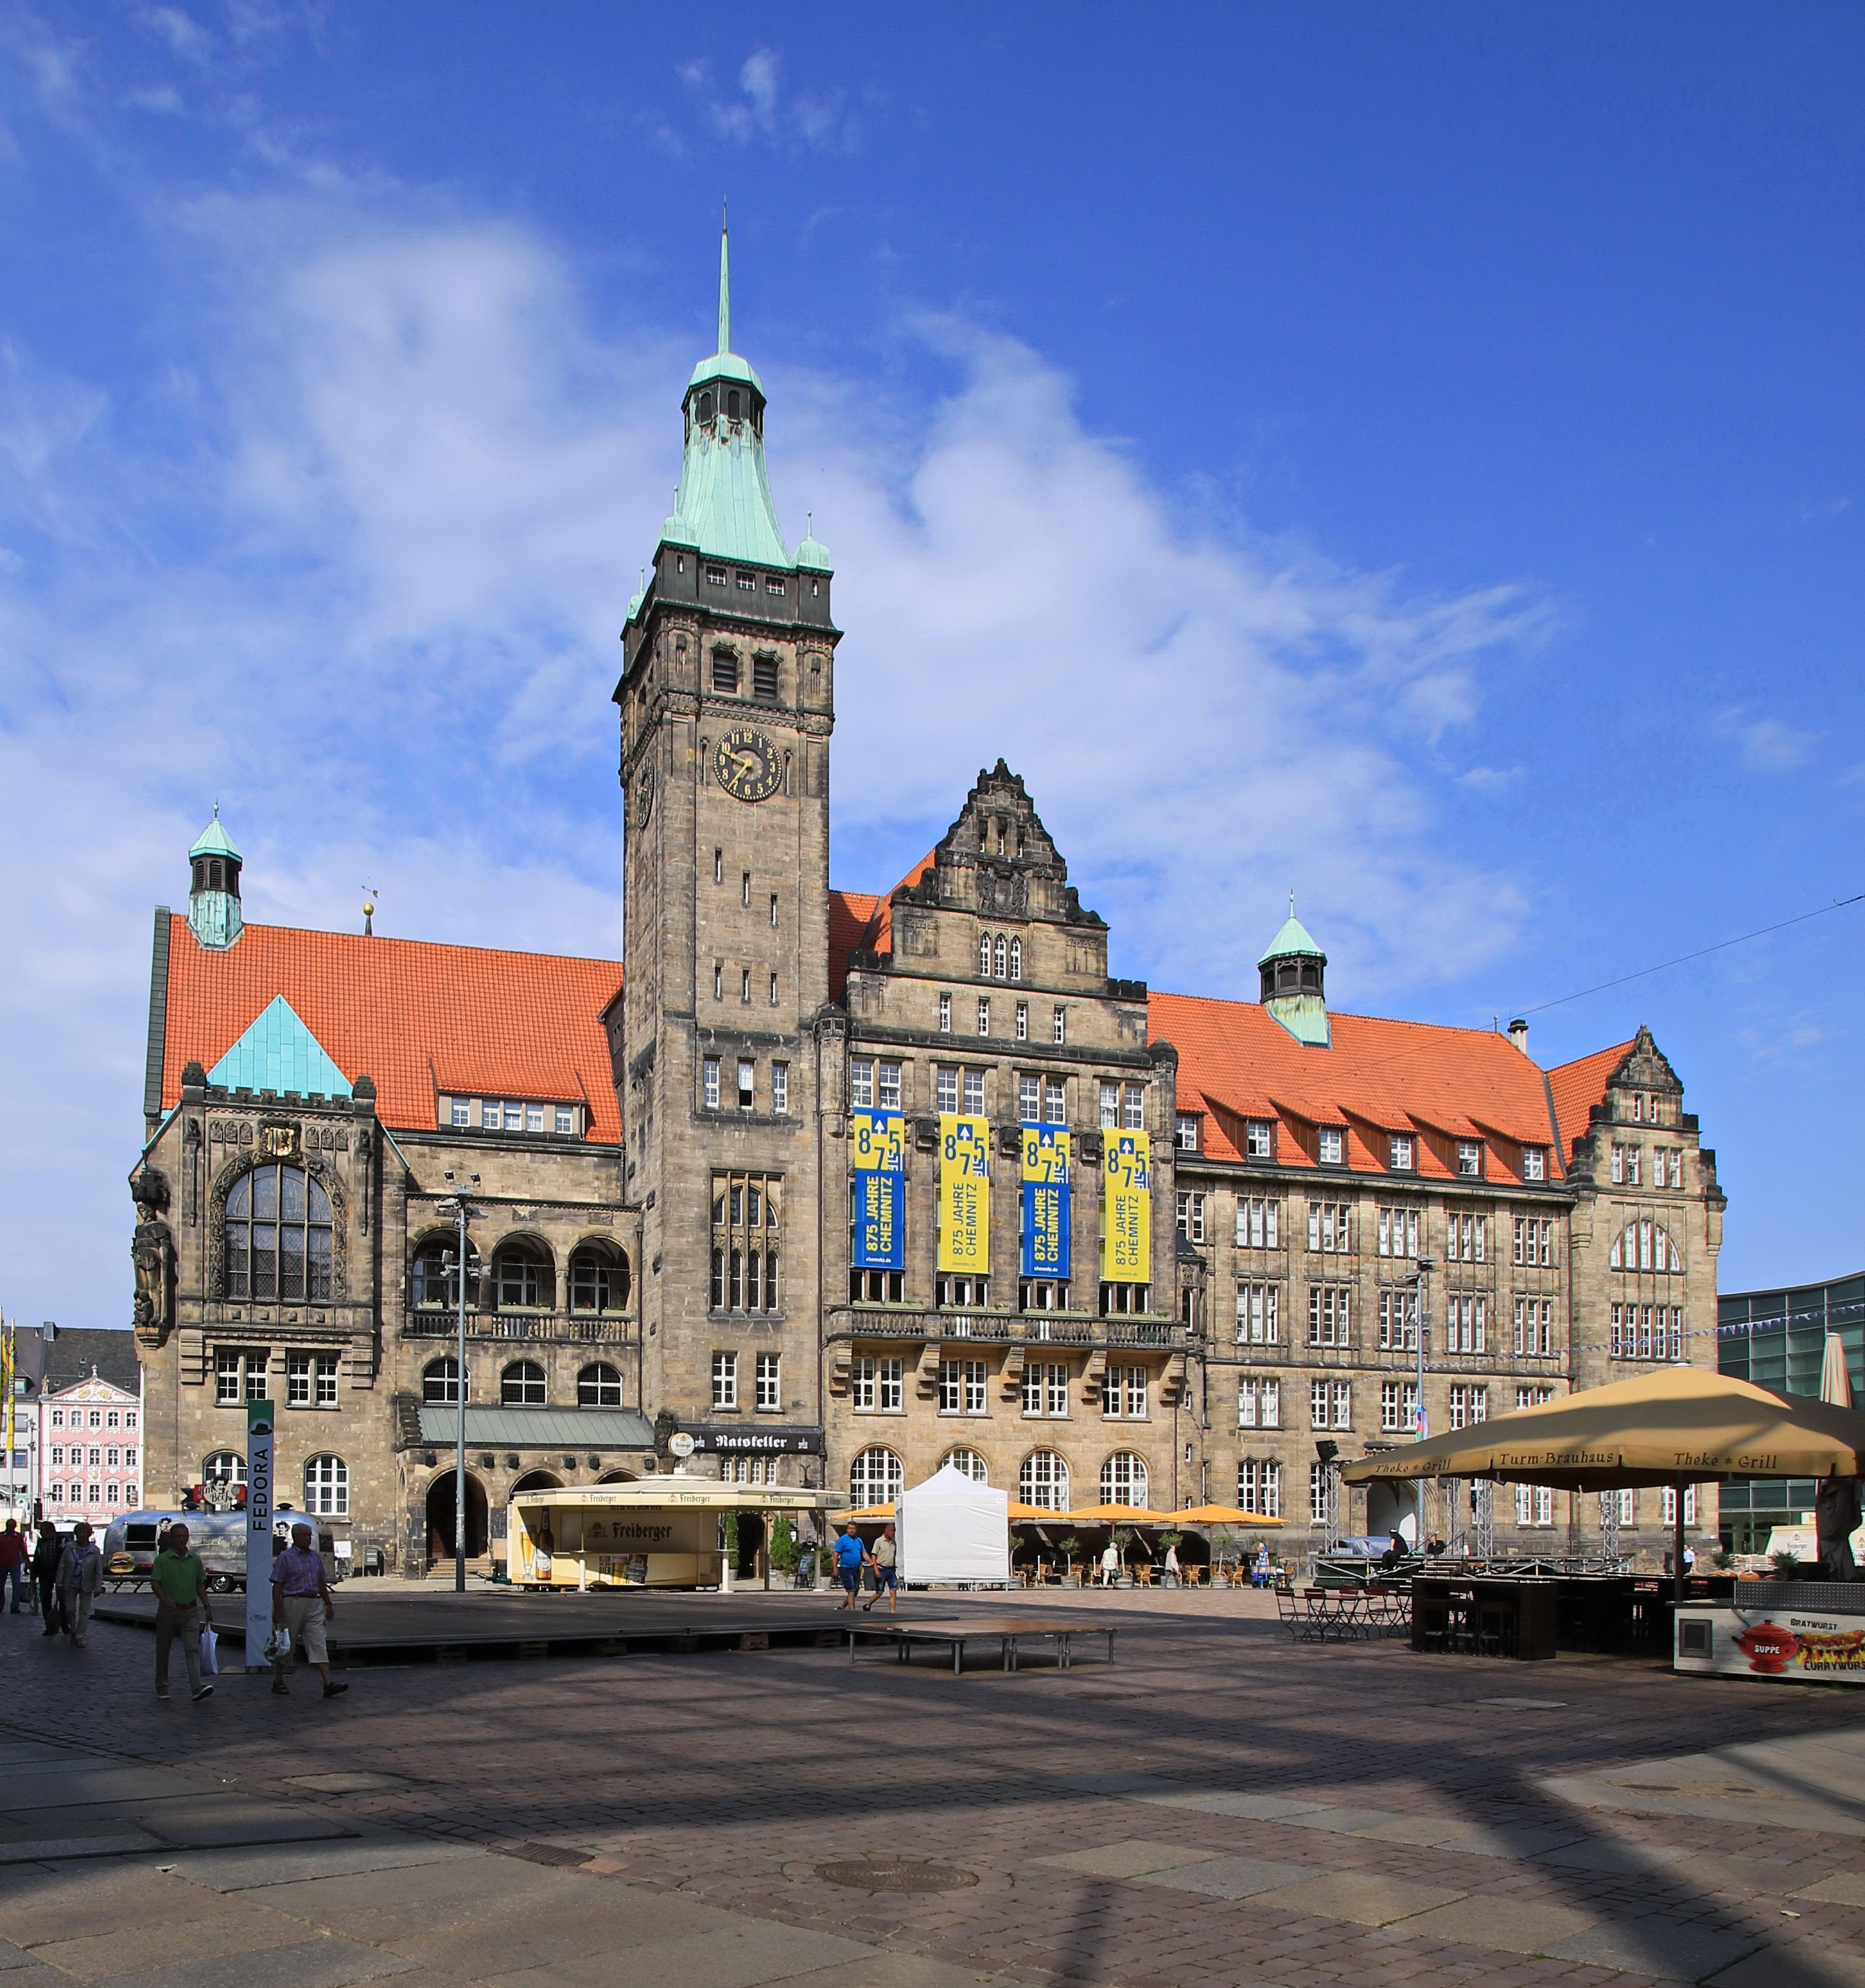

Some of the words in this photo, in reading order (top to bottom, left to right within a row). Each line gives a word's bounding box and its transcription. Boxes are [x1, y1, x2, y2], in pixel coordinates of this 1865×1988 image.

[731, 733, 739, 744] 11
[743, 732, 753, 743] 12
[758, 738, 763, 748] 1
[721, 742, 731, 752] 10
[767, 748, 773, 759] 2
[719, 754, 726, 766] 9
[722, 769, 729, 780] 8
[769, 762, 776, 773] 3
[766, 775, 773, 786] 4
[744, 784, 751, 796] 6
[757, 783, 764, 794] 5
[866, 1176, 879, 1221] JAHRE
[953, 1182, 963, 1225] JAHRE
[880, 1176, 892, 1252] CHEMNITZ
[1035, 1188, 1046, 1232] JAHRE
[1116, 1195, 1126, 1235] JAHRE
[966, 1183, 977, 1256] CHEMNITZ
[1047, 1189, 1058, 1262] CHEMNITZ
[866, 1224, 879, 1251] 875
[1128, 1195, 1139, 1266] CHEMNITZ
[952, 1230, 963, 1255] 875
[1034, 1234, 1046, 1261] 875
[1116, 1241, 1126, 1265] 875
[715, 1434, 787, 1448] Ratskeller
[1499, 1451, 1614, 1465] Turm-Brauhaus
[1674, 1452, 1718, 1467] Theke
[1738, 1454, 1777, 1469] Grill
[1375, 1463, 1409, 1473] Theke
[1423, 1458, 1451, 1471] Grill
[210, 1490, 229, 1503] Beef
[253, 1448, 268, 1531] FEDORA
[590, 1494, 617, 1504] Freiberger
[680, 1493, 711, 1504] Freiberger
[770, 1495, 794, 1505] Freiberger
[612, 1522, 672, 1542] Freiberger
[1790, 1618, 1837, 1630] BRATWURST
[1754, 1644, 1780, 1654] SUPPE
